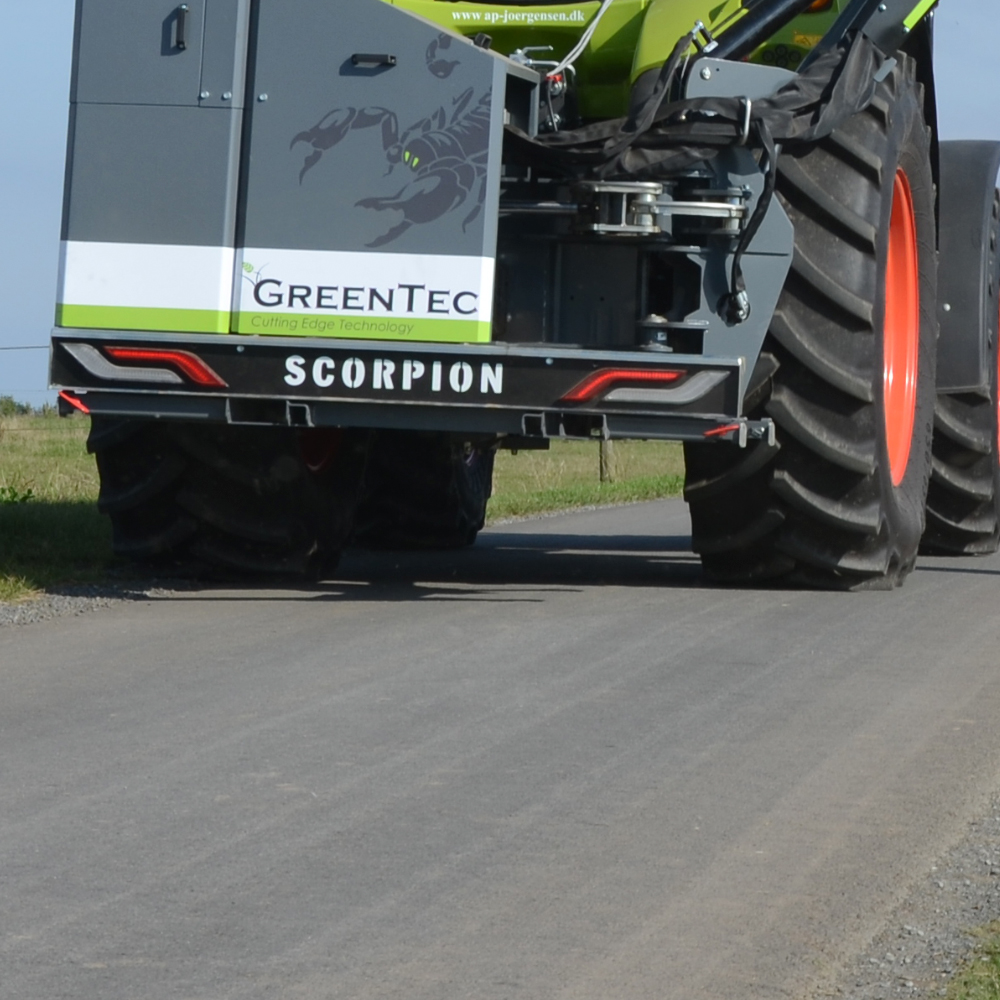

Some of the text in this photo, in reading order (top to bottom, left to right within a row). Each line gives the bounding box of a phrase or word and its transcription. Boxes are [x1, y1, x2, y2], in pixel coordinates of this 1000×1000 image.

[251, 315, 415, 335] Cutting Edge Technology
[283, 354, 504, 395] SCORPION
